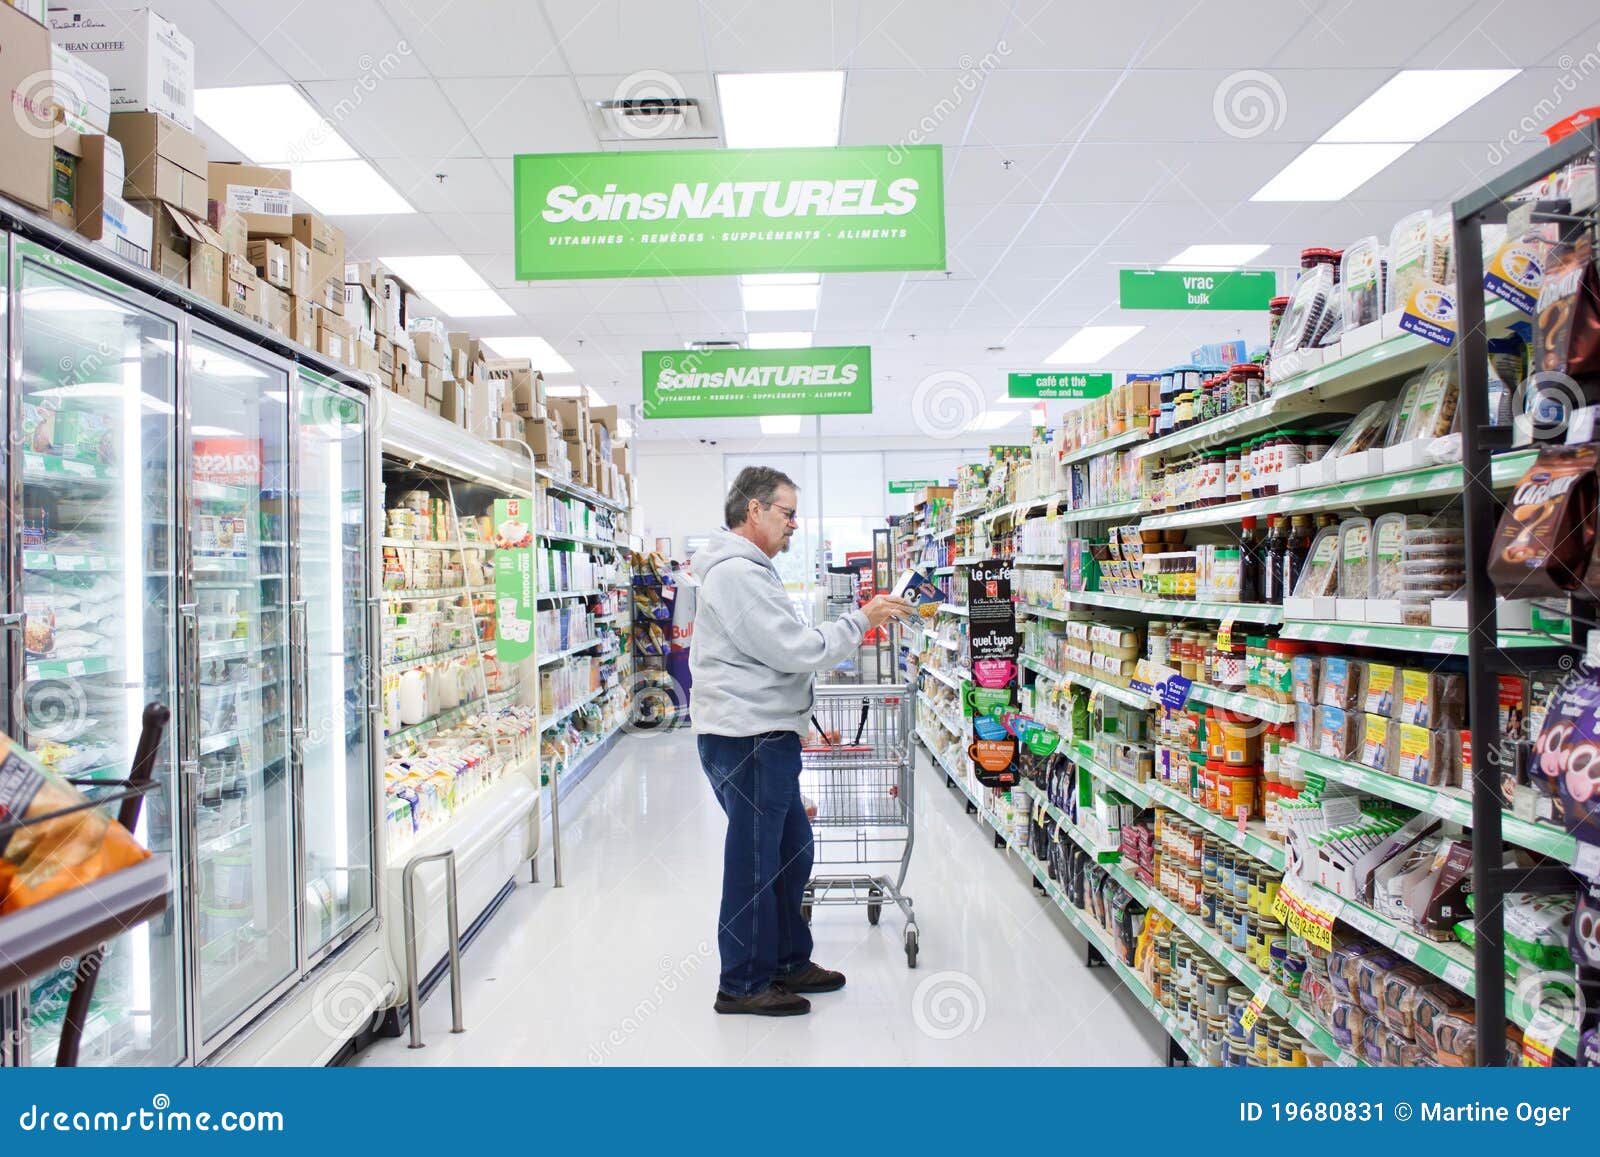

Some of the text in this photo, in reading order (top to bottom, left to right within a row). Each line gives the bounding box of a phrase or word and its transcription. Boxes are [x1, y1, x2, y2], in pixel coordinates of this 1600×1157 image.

[65, 42, 89, 51] BEAN
[91, 41, 125, 50] COFFEE
[542, 177, 920, 223] SoinsNATURELS
[549, 229, 907, 246] VITAMINES REMÈDES SUPPLÉMENTS ALIMENTS
[1183, 275, 1214, 289] vrac
[1188, 292, 1209, 304] bulk
[1036, 375, 1086, 387] café et thé
[973, 635, 992, 648] quel
